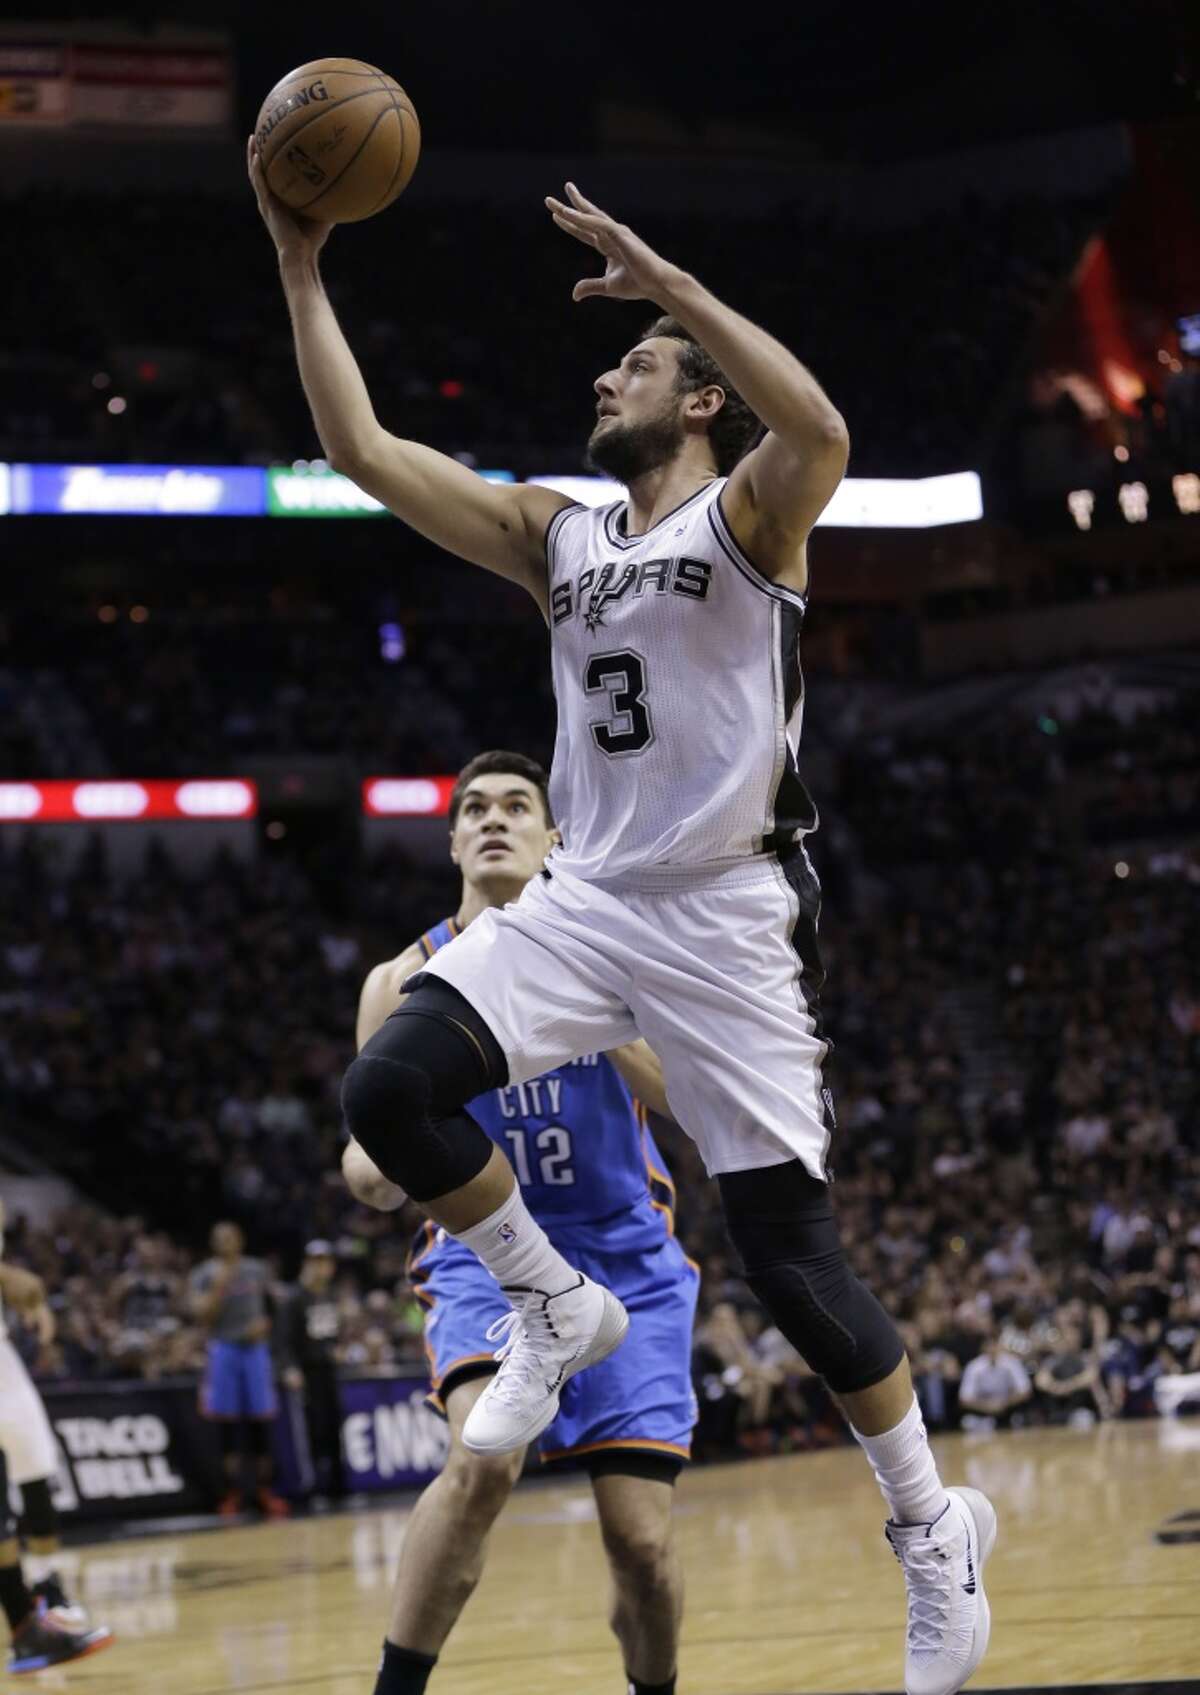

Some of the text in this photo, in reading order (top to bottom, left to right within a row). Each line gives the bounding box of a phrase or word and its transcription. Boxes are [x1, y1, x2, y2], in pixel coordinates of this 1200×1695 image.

[551, 556, 713, 634] SPURS
[583, 647, 656, 760] 3
[497, 1078, 561, 1118] CITY
[504, 1126, 575, 1186] 12
[56, 1414, 169, 1457] TACO
[74, 1456, 184, 1499] BELL
